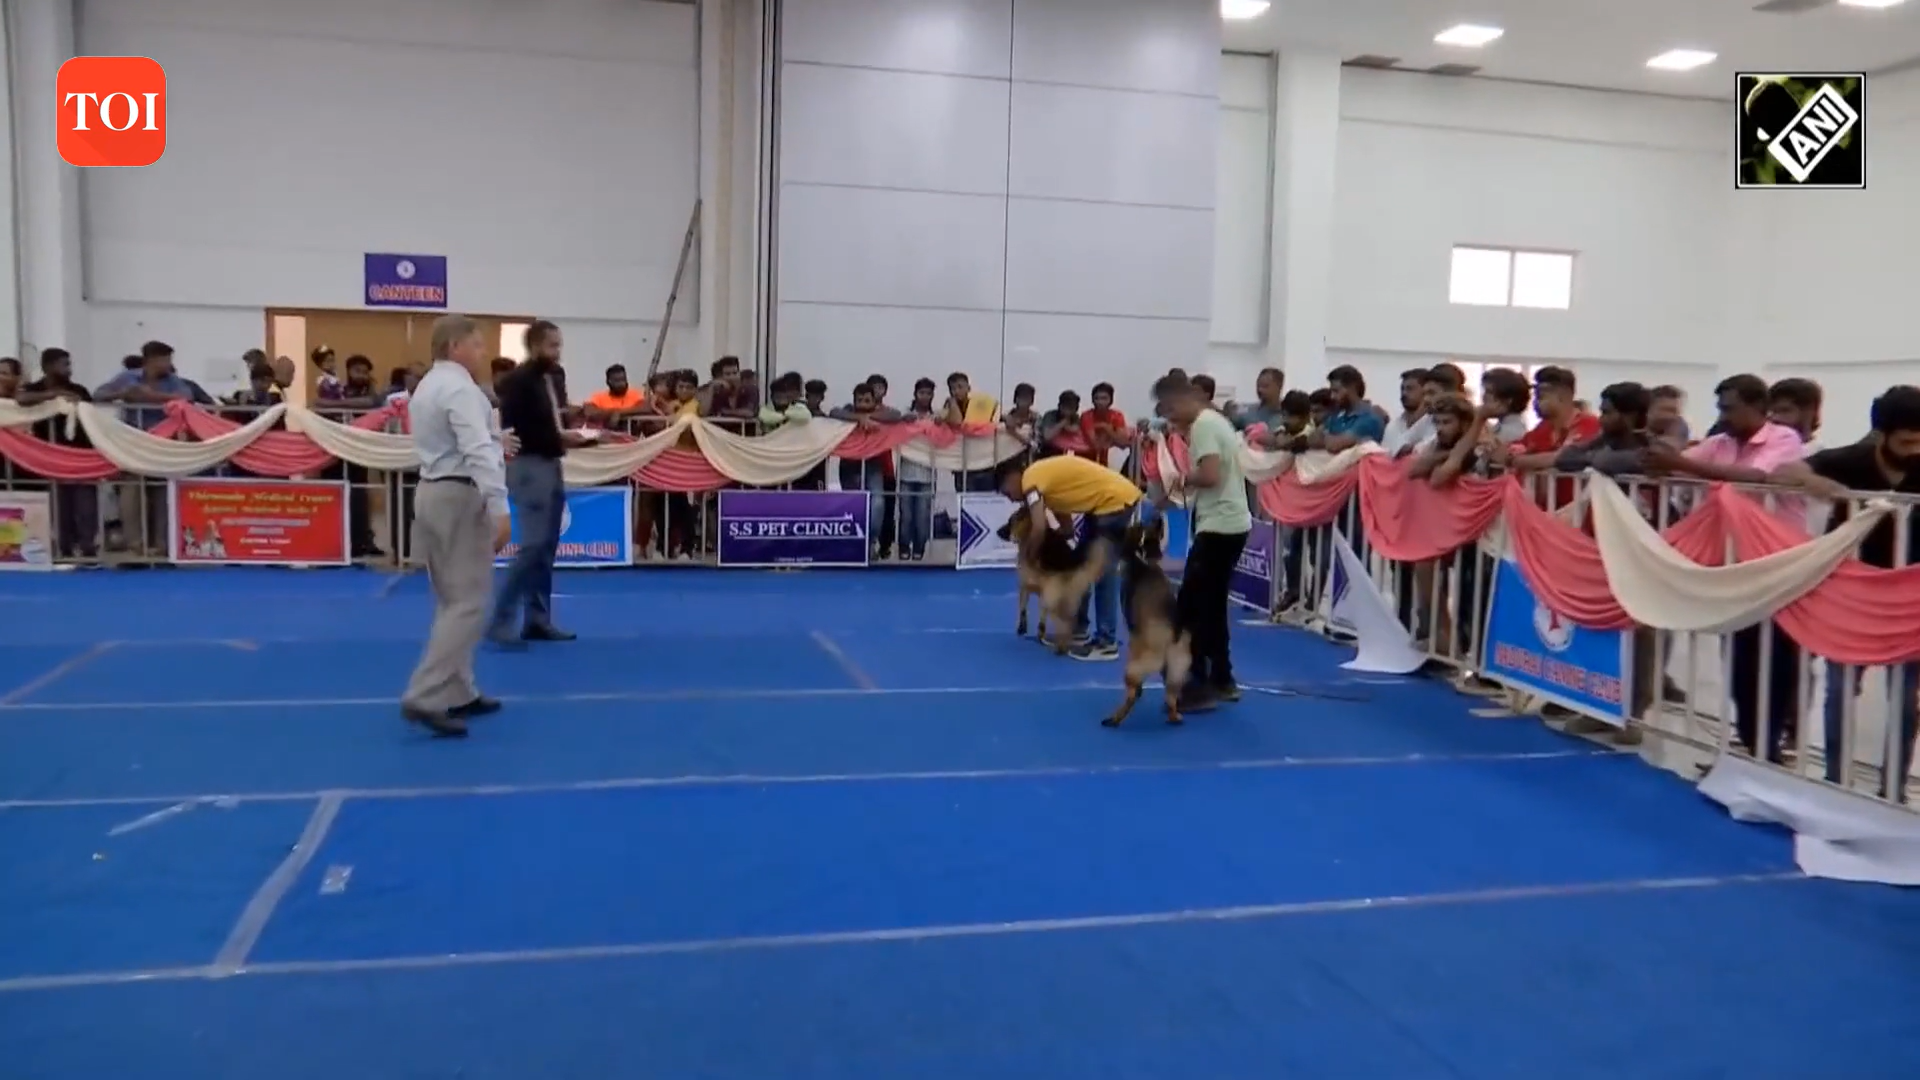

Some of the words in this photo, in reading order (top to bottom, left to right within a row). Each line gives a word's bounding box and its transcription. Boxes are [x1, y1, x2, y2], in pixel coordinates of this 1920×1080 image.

[369, 285, 444, 302] CANTEEN
[729, 522, 752, 536] S.S
[758, 522, 788, 536] PET
[793, 522, 851, 536] CLINIC
[586, 542, 619, 557] CLUB
